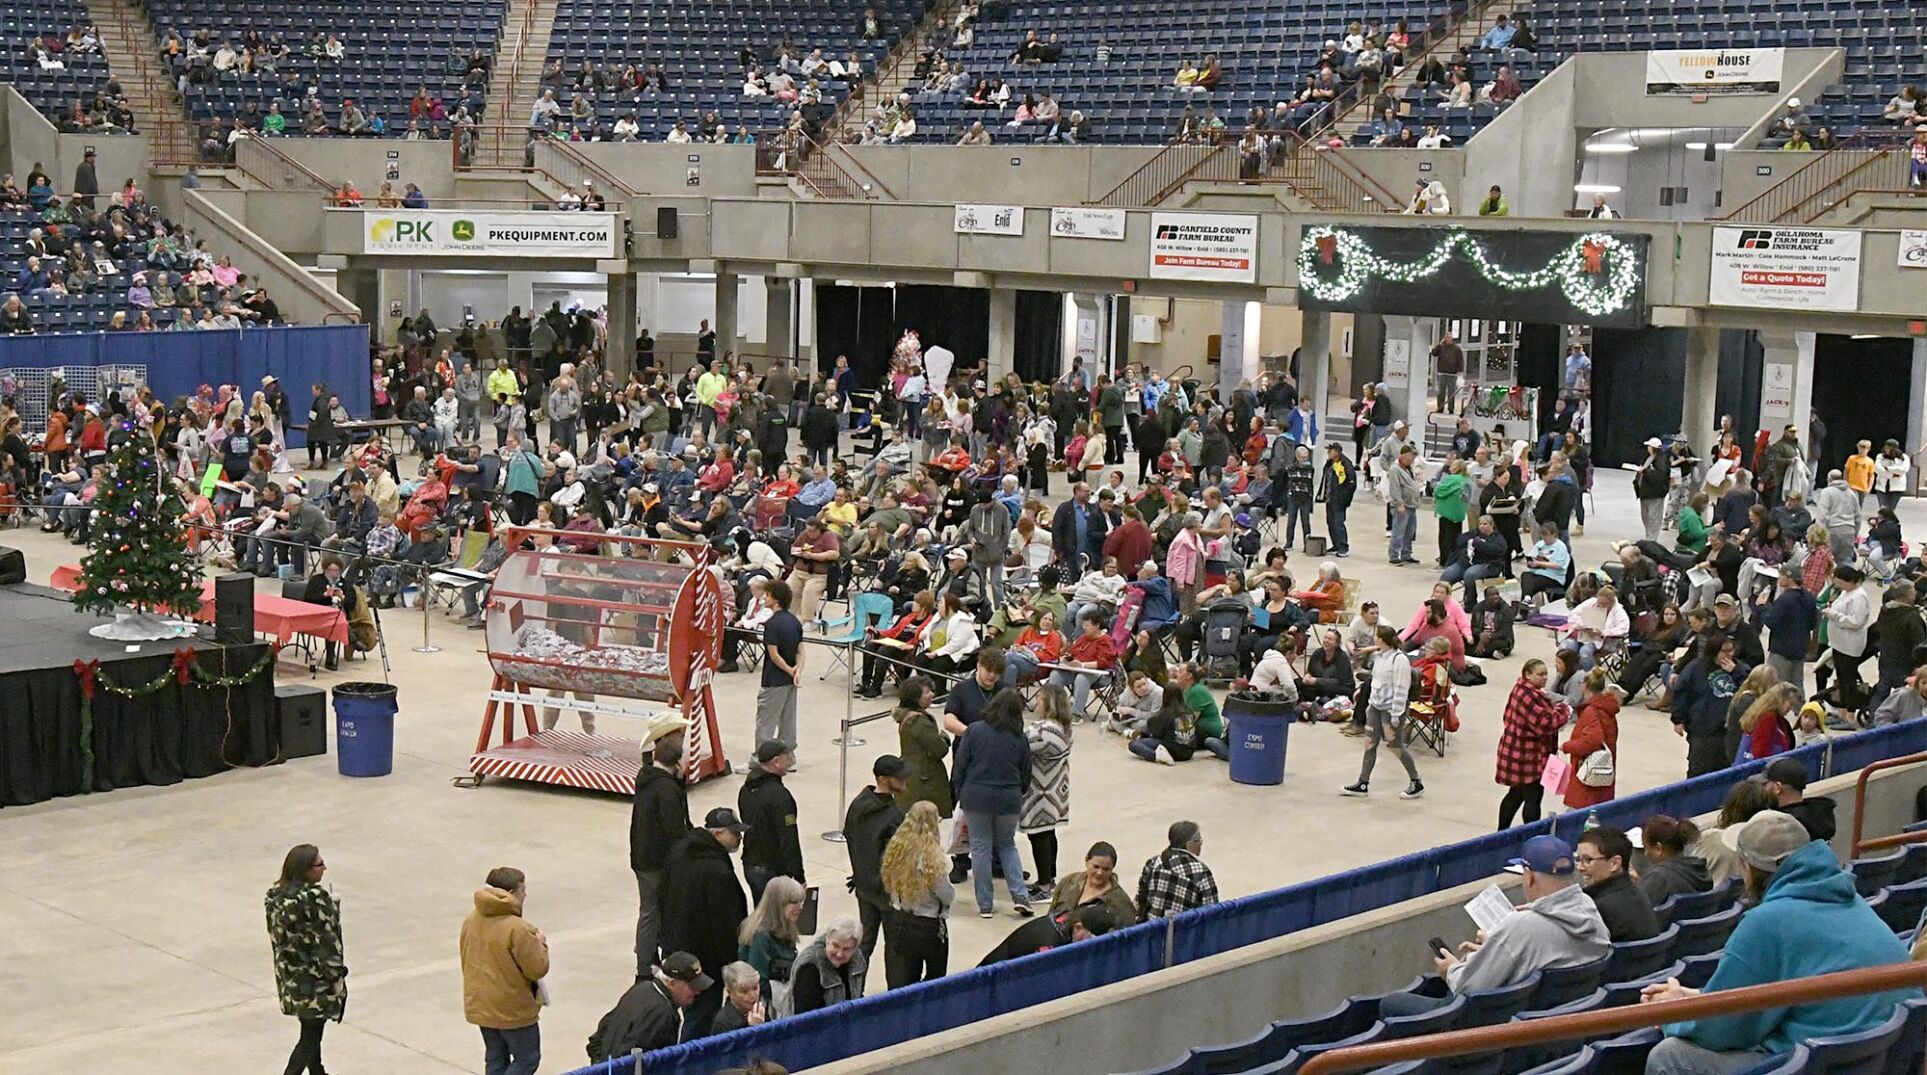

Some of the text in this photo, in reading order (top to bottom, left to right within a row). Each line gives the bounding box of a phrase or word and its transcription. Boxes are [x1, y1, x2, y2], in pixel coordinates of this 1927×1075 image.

[1680, 54, 1751, 67] YELLOWHOUSE
[489, 230, 607, 242] PKEQUIPMENT.COM
[1180, 225, 1252, 235] GARFIELD COUNTY
[1178, 233, 1235, 242] FARM BUREAU
[1179, 257, 1195, 265] Farm
[1196, 258, 1220, 266] Bureau
[1220, 259, 1242, 269] Today!
[1743, 273, 1758, 281] Get
[1767, 274, 1794, 283] Quote
[1796, 275, 1825, 285] Today!
